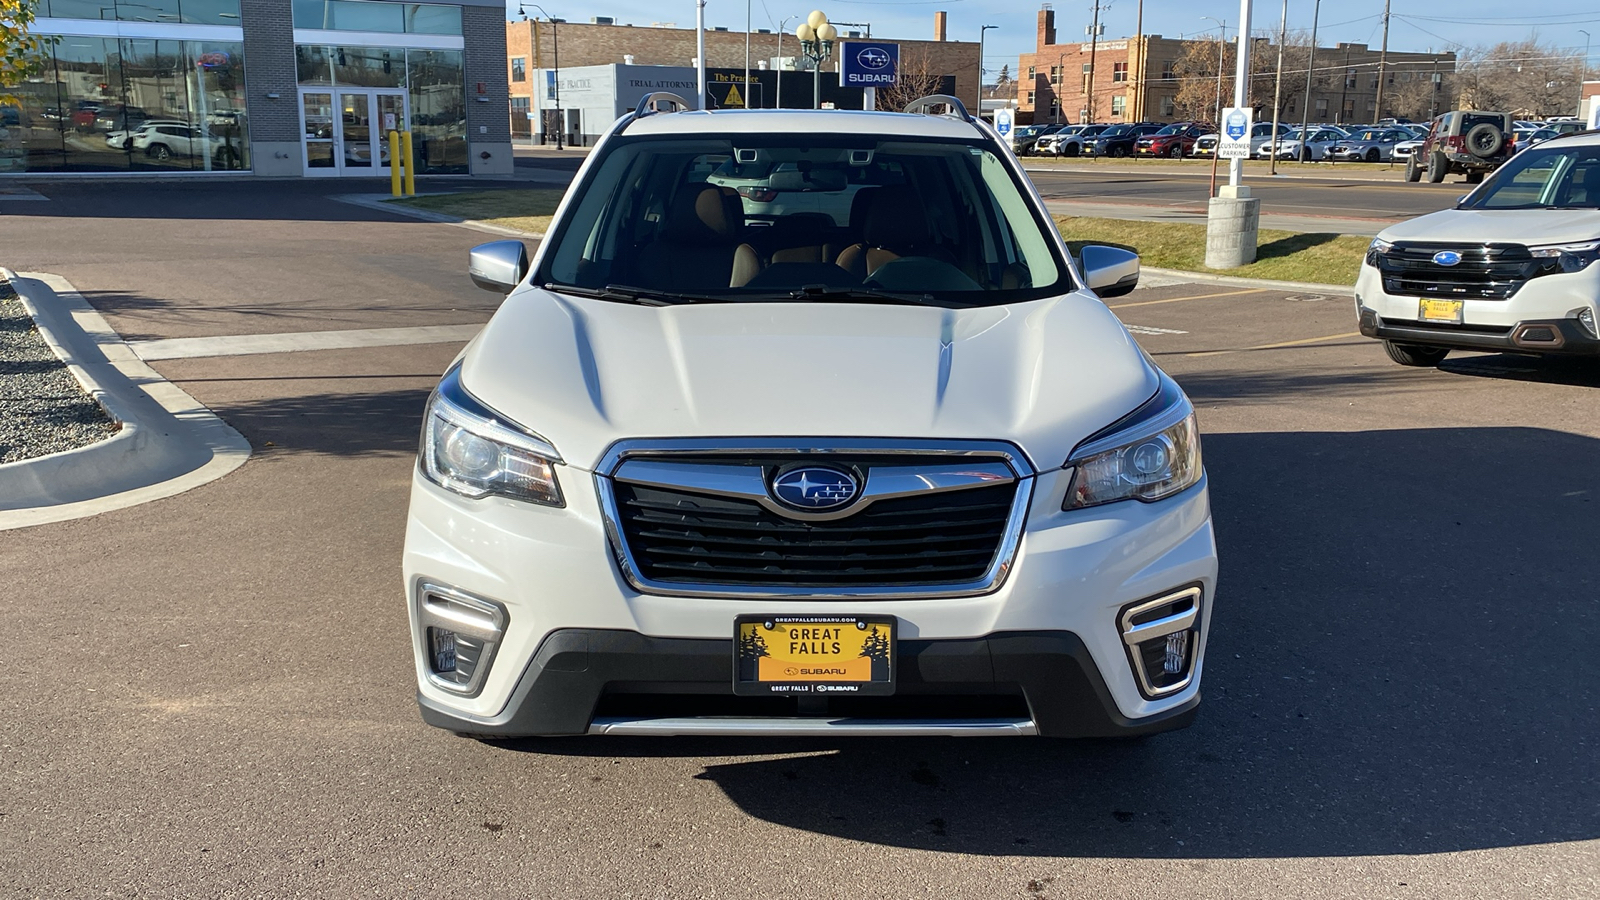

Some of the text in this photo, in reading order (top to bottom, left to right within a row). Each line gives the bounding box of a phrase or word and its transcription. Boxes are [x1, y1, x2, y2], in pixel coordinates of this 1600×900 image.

[714, 73, 759, 83] The Pracice
[848, 73, 896, 83] SUBARU
[630, 79, 654, 88] TRIAL
[1220, 142, 1250, 150] CUSTOMER
[789, 628, 841, 640] GREAT
[789, 641, 841, 655] FALLS
